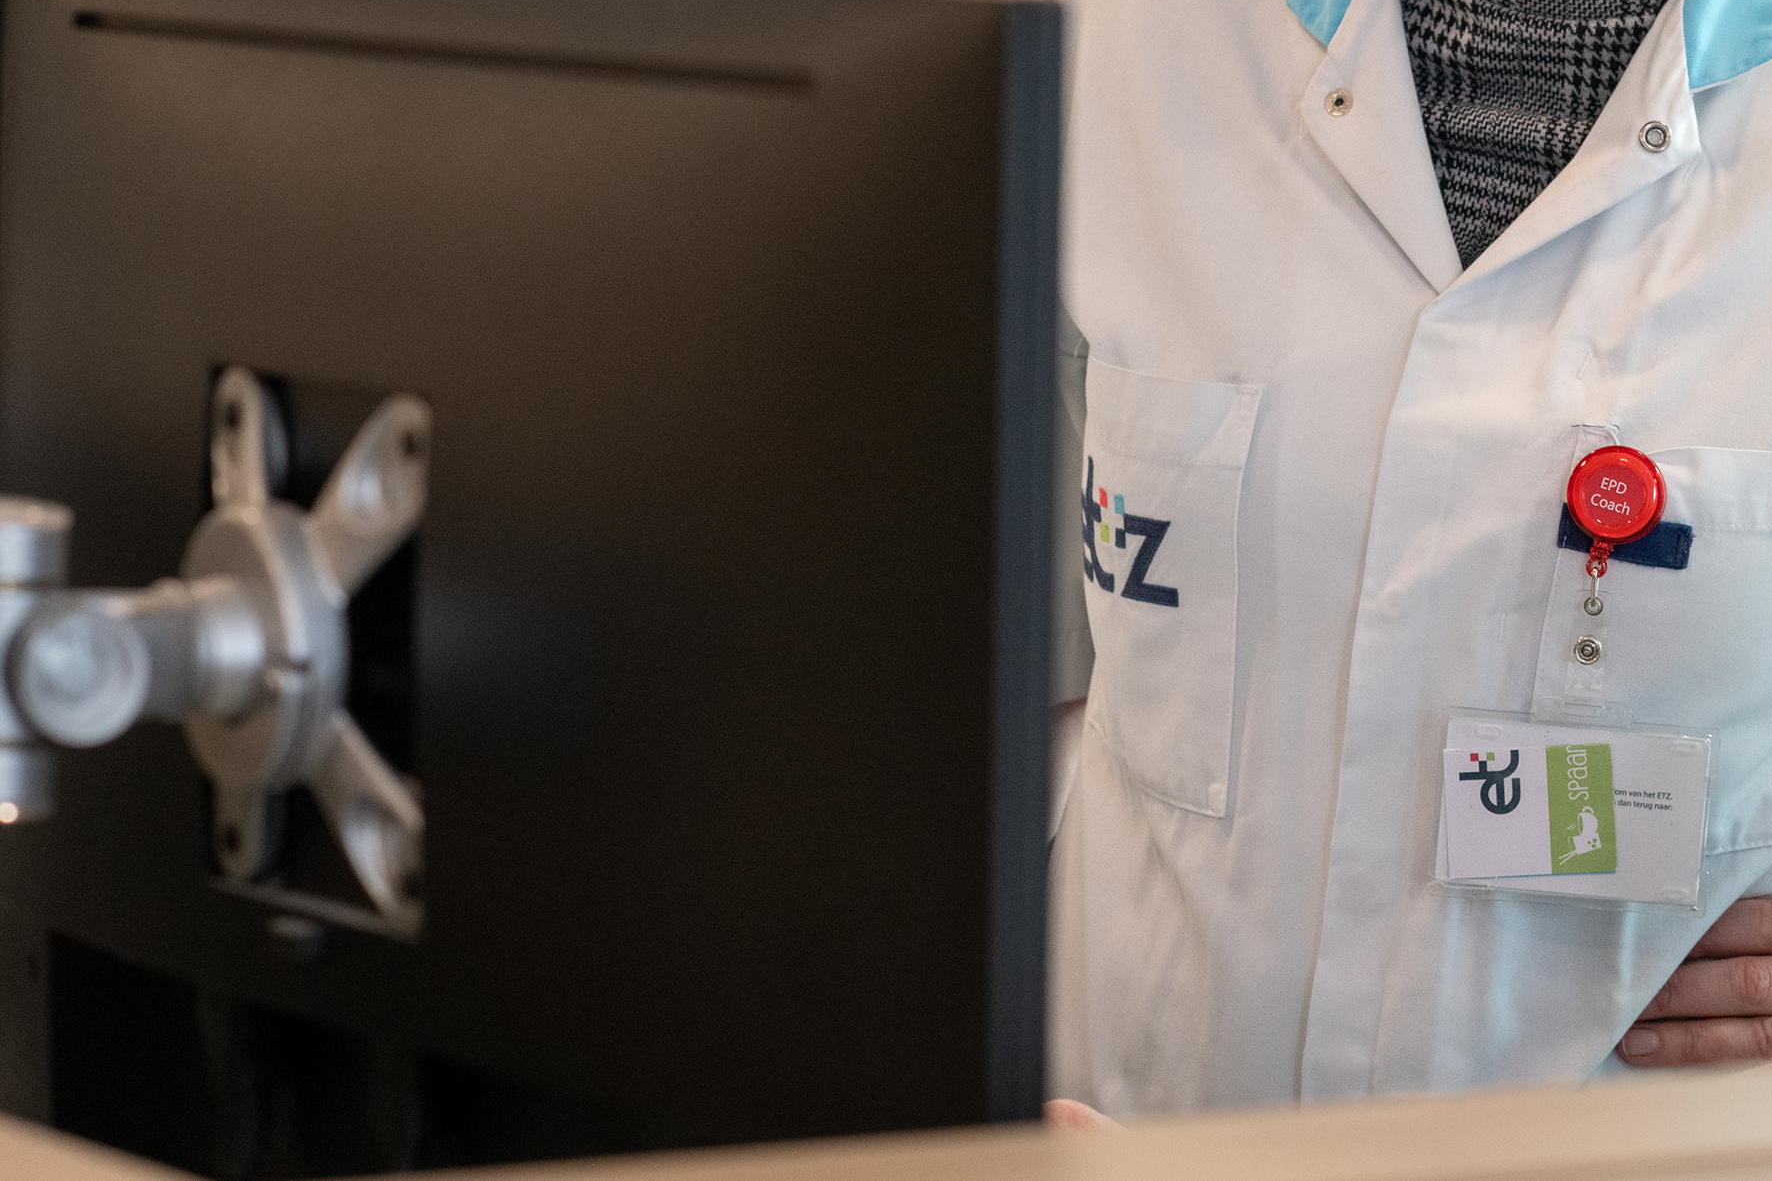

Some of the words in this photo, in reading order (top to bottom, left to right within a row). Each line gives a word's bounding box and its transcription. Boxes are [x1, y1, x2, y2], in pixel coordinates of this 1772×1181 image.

[1600, 476, 1628, 495] EPD
[1590, 493, 1631, 516] Coach
[1613, 788, 1627, 796] om
[1643, 790, 1656, 799] het
[1617, 799, 1632, 807] dan
[1633, 801, 1653, 810] terug
